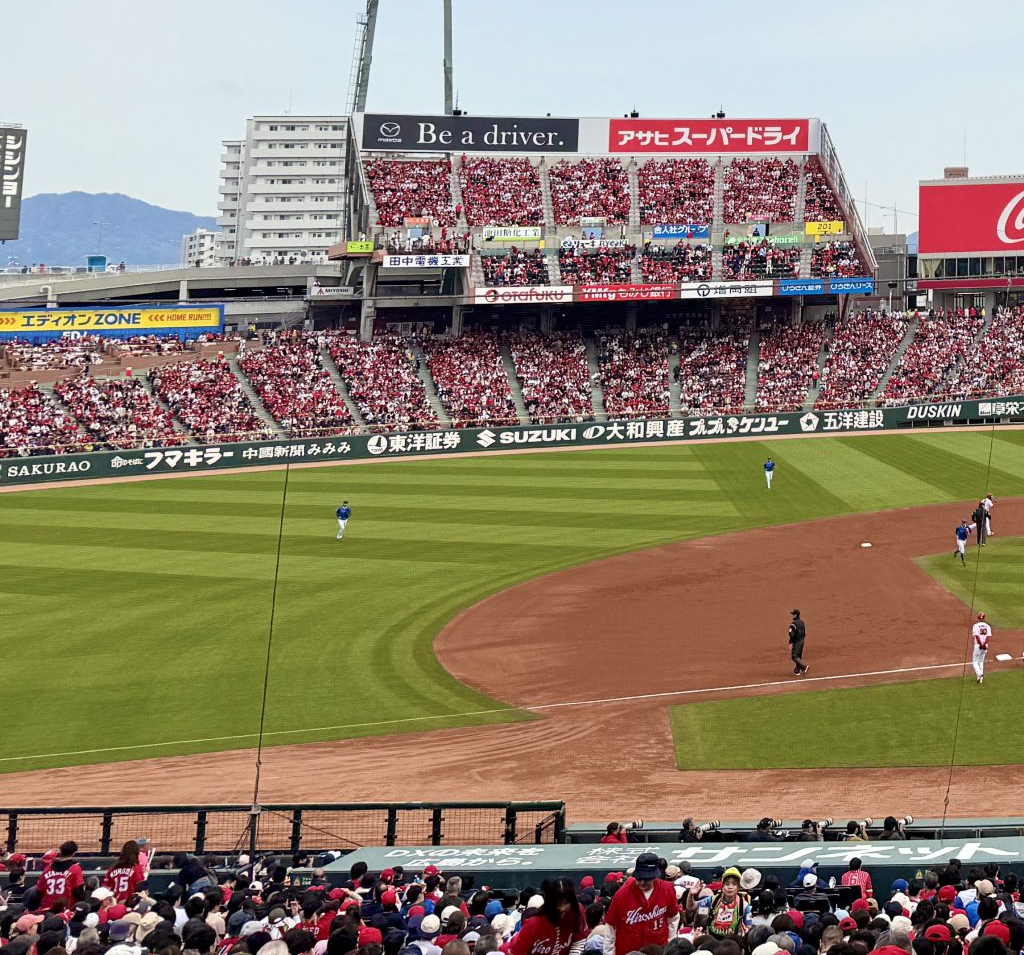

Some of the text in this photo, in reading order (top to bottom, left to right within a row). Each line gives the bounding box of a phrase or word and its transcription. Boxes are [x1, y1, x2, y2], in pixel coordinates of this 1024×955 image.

[417, 122, 565, 146] Be a driver.
[389, 255, 463, 267] 田中電機工業
[21, 313, 91, 327] エディオン
[94, 312, 141, 325] ZONE
[166, 314, 187, 322] HOME
[822, 410, 884, 430] 五洋建設
[906, 404, 962, 419] DUSKIN
[499, 429, 576, 444] SUZUKI
[606, 419, 685, 440] 大和興産
[307, 442, 352, 455] みみみ
[389, 432, 461, 453] 東洋証券
[144, 448, 234, 470] フマキラー
[7, 461, 91, 478] SAKURAO
[384, 847, 545, 858] DXの未来を
[668, 842, 1020, 864] サンネット
[402, 857, 534, 868] 広島から。
[46, 878, 66, 895] 33
[114, 876, 129, 893] 15
